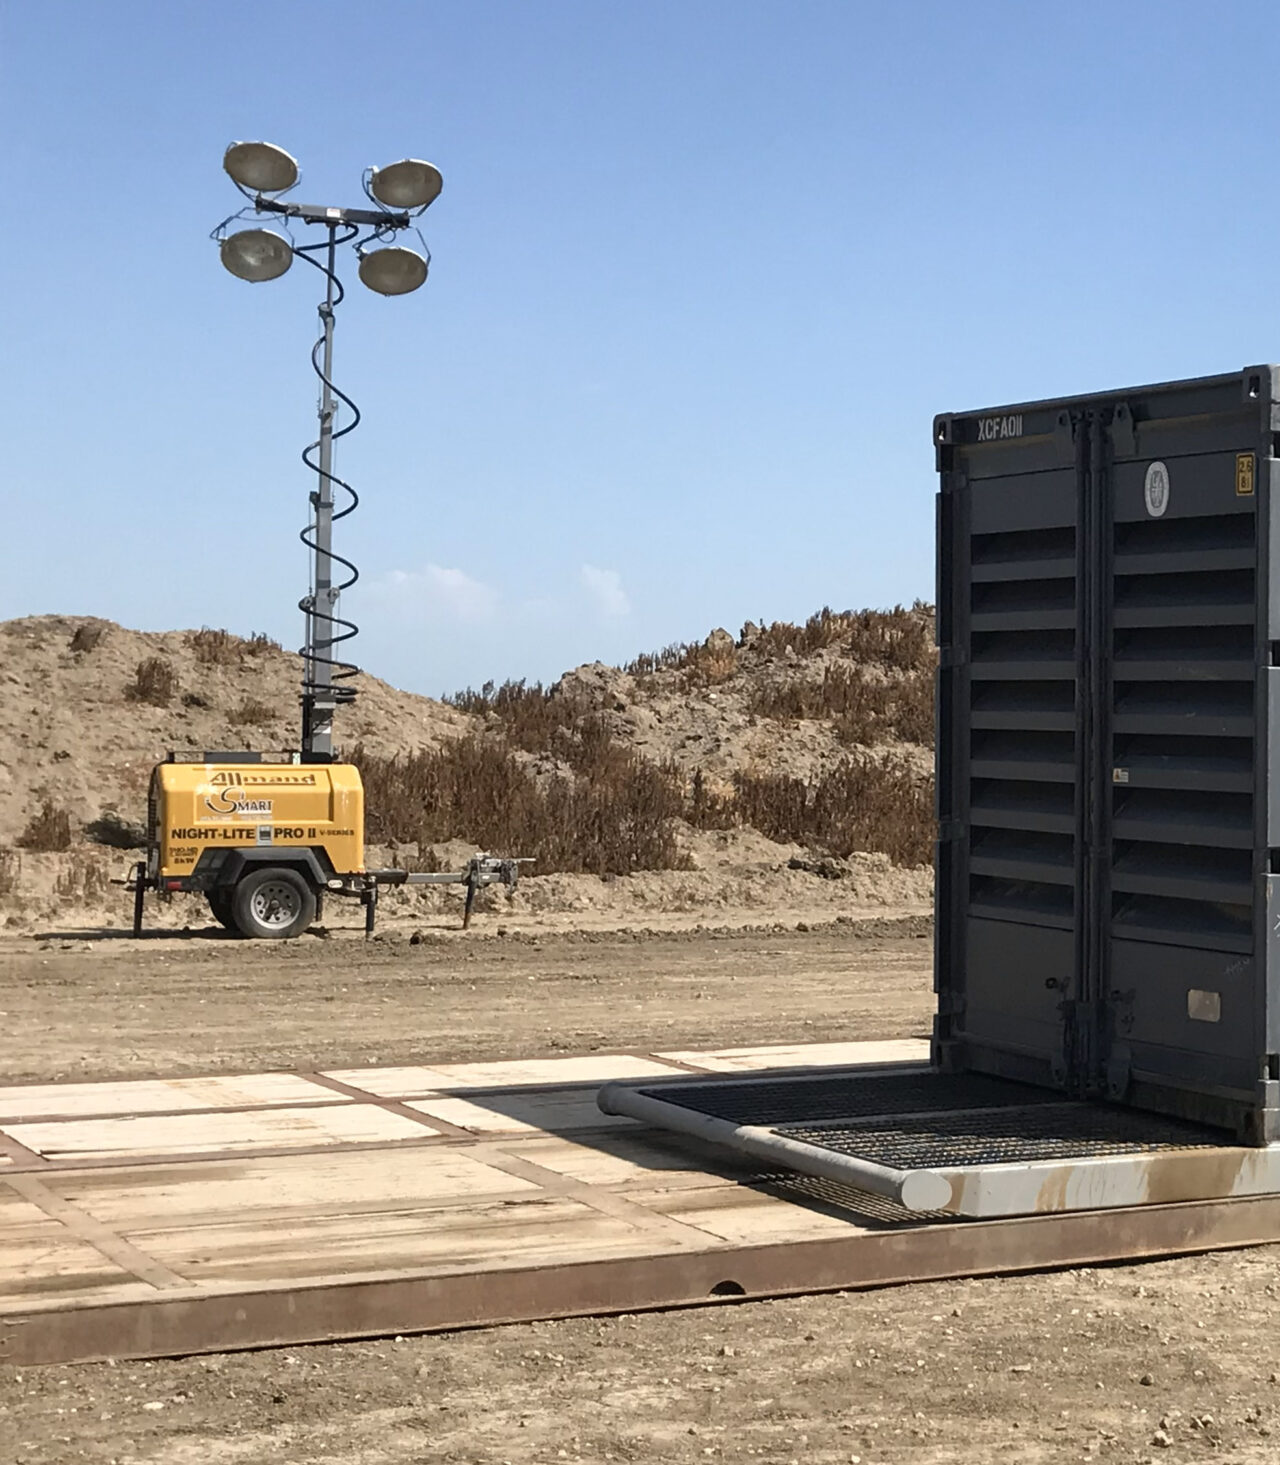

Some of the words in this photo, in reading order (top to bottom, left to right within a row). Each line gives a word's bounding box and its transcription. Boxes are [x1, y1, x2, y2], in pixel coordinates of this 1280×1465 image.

[209, 772, 317, 786] Allmand
[171, 828, 256, 839] NIGHT-LITE
[274, 828, 304, 838] PRO
[307, 828, 316, 838] II
